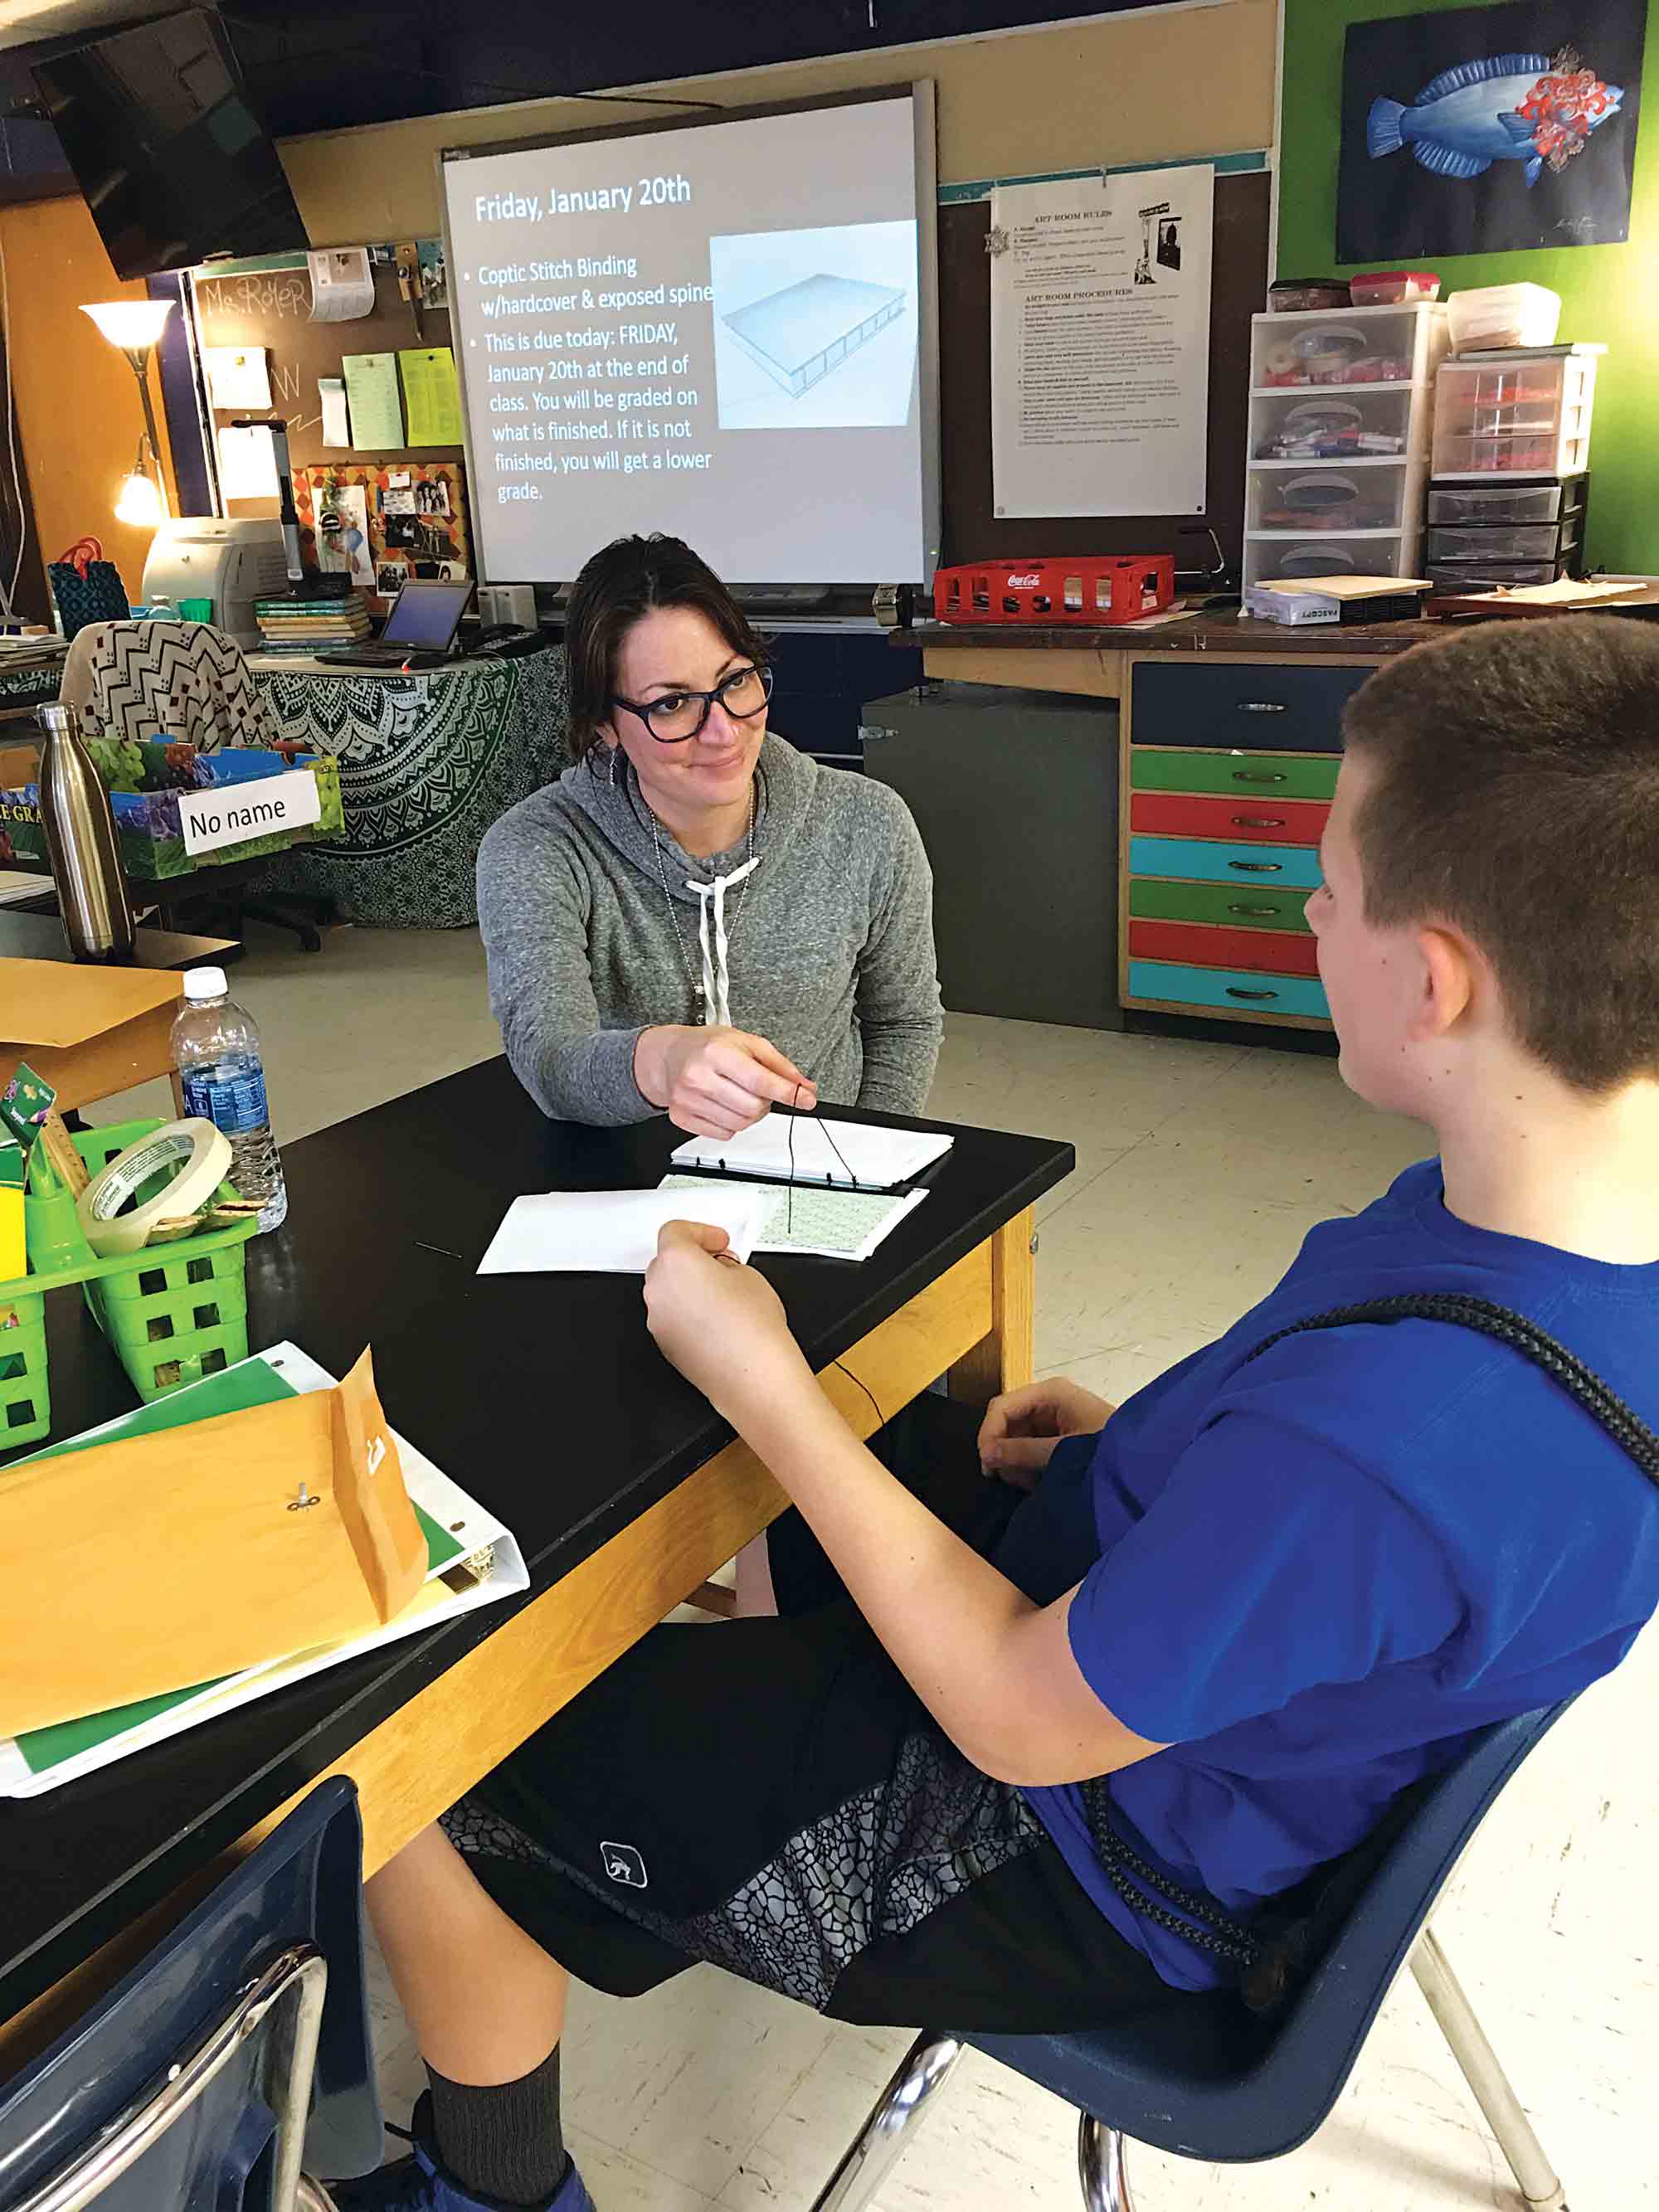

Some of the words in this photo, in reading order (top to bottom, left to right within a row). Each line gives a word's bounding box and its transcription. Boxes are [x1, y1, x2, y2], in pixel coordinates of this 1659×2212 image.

[475, 192, 544, 221] Friday,
[548, 186, 633, 214] January
[638, 174, 691, 206] 20th
[1054, 212, 1080, 221] ROOM
[478, 266, 527, 287] Coptic
[530, 259, 572, 281] Stitch
[577, 255, 638, 278] Binding
[481, 293, 577, 318] w/hardcover
[581, 289, 596, 309] &
[598, 283, 664, 310] exposed
[669, 282, 714, 307] spine
[1025, 294, 1043, 304] ART
[1045, 292, 1071, 301] ROOM
[1073, 288, 1134, 299] PROCEDURES
[484, 333, 515, 352] This
[518, 333, 530, 351] is
[533, 330, 562, 349] due
[566, 327, 615, 350] today:
[620, 323, 678, 346] FRIDAY,
[488, 363, 544, 384] January
[548, 360, 582, 381] 20th
[587, 361, 602, 378] at
[606, 359, 632, 377] the
[637, 355, 668, 376] end
[672, 354, 689, 374] of
[489, 393, 528, 412] class.
[532, 391, 560, 411] You
[563, 390, 590, 409] will
[594, 389, 613, 408] be
[617, 386, 672, 411] graded
[676, 389, 698, 406] on
[492, 422, 529, 441] what
[532, 422, 545, 440] is
[547, 419, 613, 440] finished.
[617, 419, 628, 439] If
[630, 419, 644, 438] it
[647, 419, 659, 438] is
[664, 420, 692, 438] not
[494, 453, 557, 473] finished,
[561, 455, 590, 474] you
[592, 451, 620, 470] will
[624, 453, 649, 473] get
[653, 455, 661, 469] a
[666, 450, 712, 469] lower
[498, 481, 542, 503] grade.
[13, 805, 44, 823] GRA
[190, 813, 221, 839] No
[227, 800, 286, 829] name
